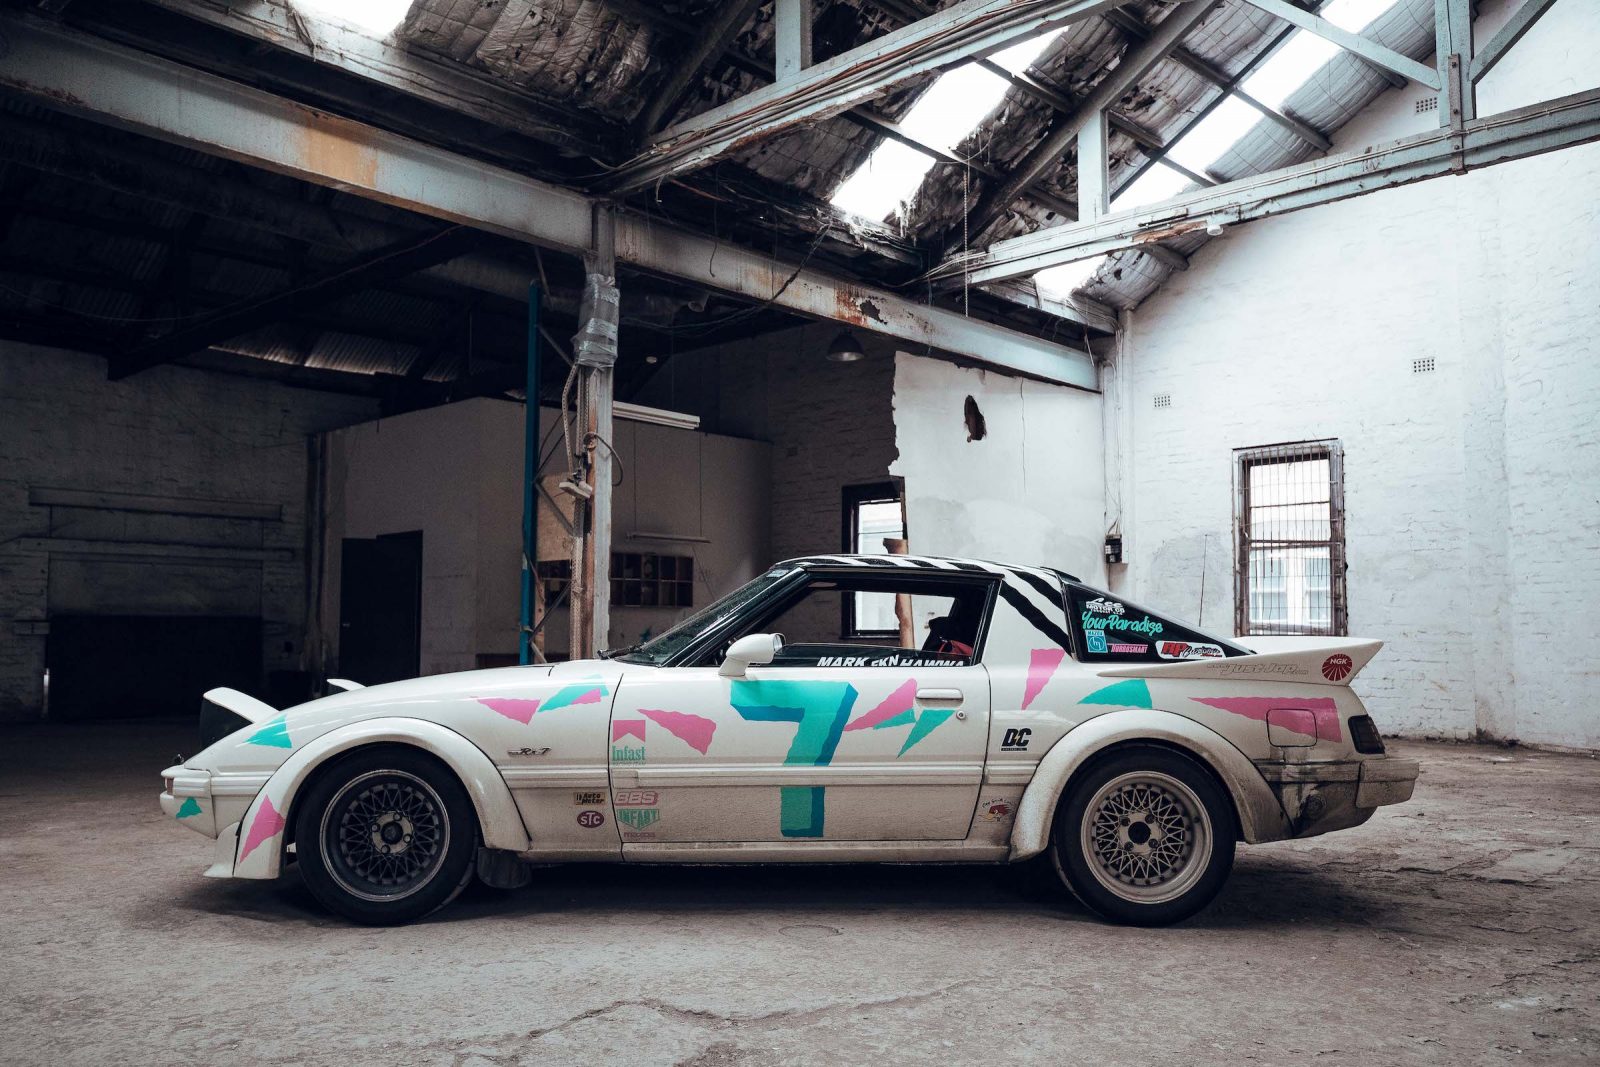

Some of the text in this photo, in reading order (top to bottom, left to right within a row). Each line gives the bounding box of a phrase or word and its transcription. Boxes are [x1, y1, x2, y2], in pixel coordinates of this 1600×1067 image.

[816, 656, 869, 667] MARK
[1001, 728, 1032, 747] DC
[612, 745, 646, 761] Infast
[614, 790, 659, 806] BBS
